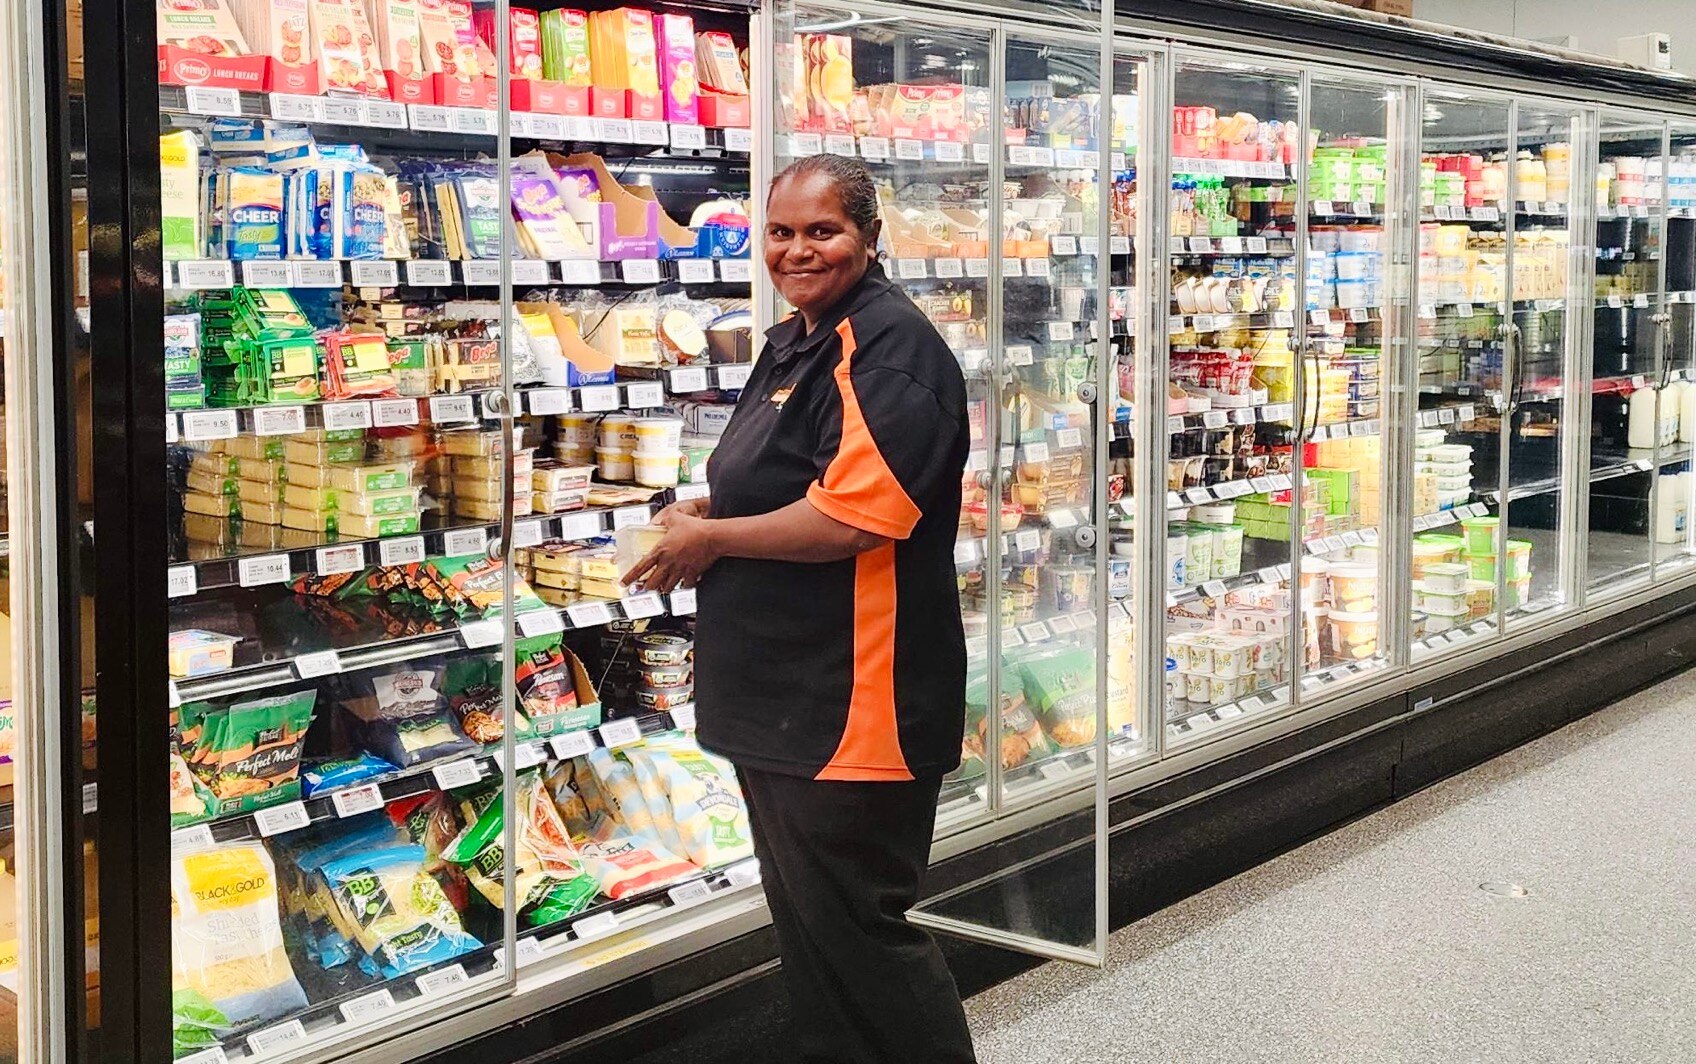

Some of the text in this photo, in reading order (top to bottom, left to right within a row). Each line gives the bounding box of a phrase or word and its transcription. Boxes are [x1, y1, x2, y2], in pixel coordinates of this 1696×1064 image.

[178, 62, 208, 78] Primo
[233, 210, 280, 223] CHEER
[239, 229, 262, 242] Tasty
[388, 346, 412, 364] ega
[470, 342, 498, 364] Bega
[235, 753, 272, 776] Perfect
[480, 846, 504, 873] BB
[346, 877, 376, 897] BB
